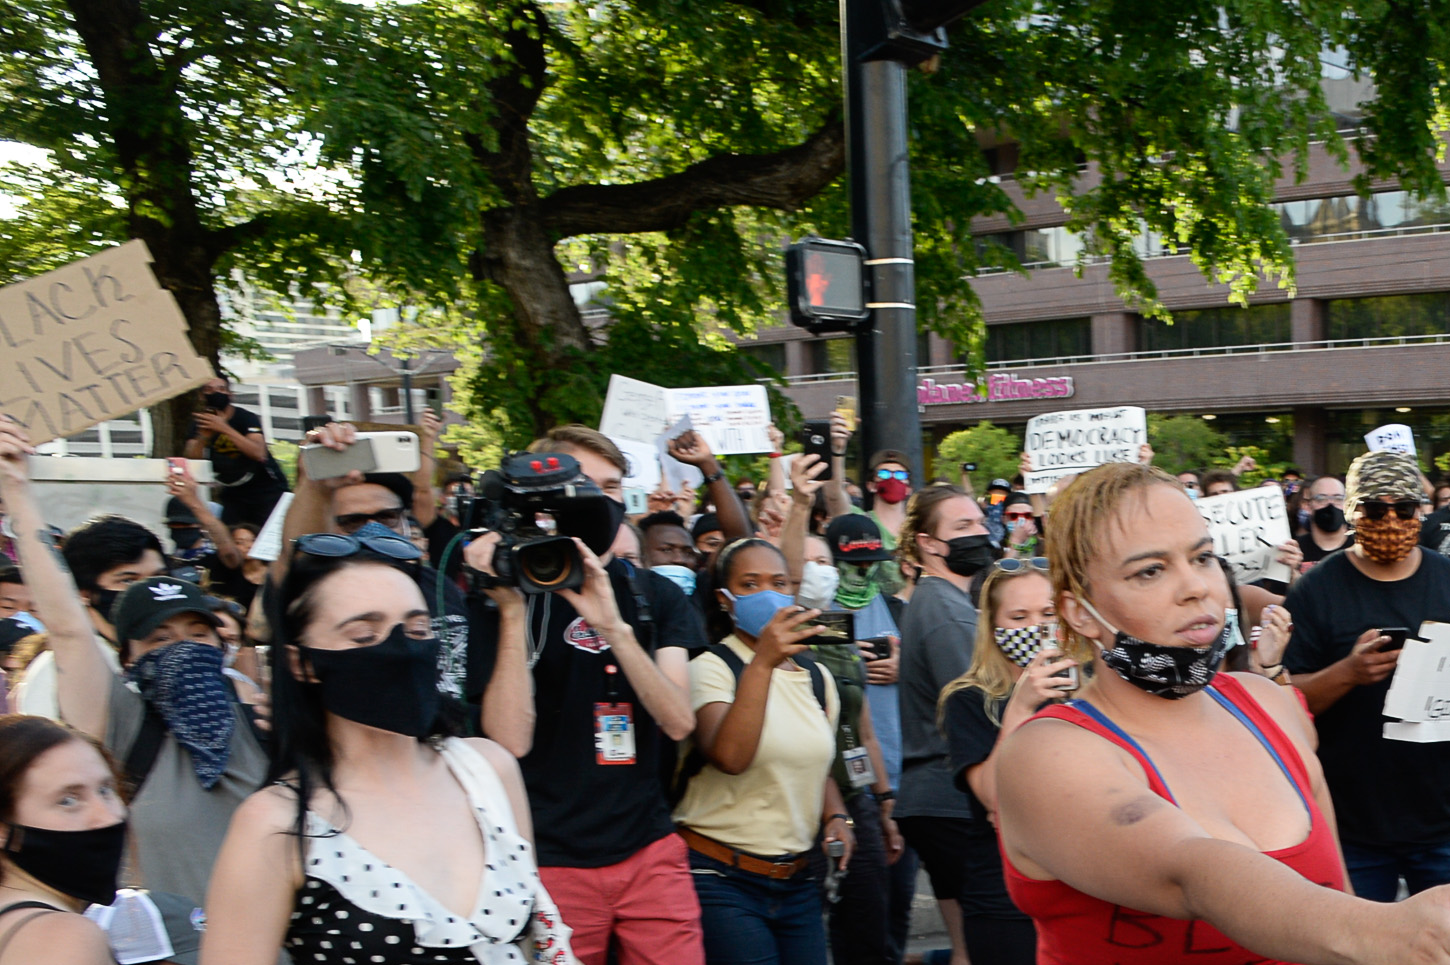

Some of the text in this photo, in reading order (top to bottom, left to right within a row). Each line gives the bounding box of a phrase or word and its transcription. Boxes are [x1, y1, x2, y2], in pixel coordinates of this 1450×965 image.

[3, 319, 144, 404] IVES
[916, 373, 1075, 413] plane fitness
[1029, 427, 1142, 451] DEMOCRACY
[1038, 451, 1086, 467] LOOKS
